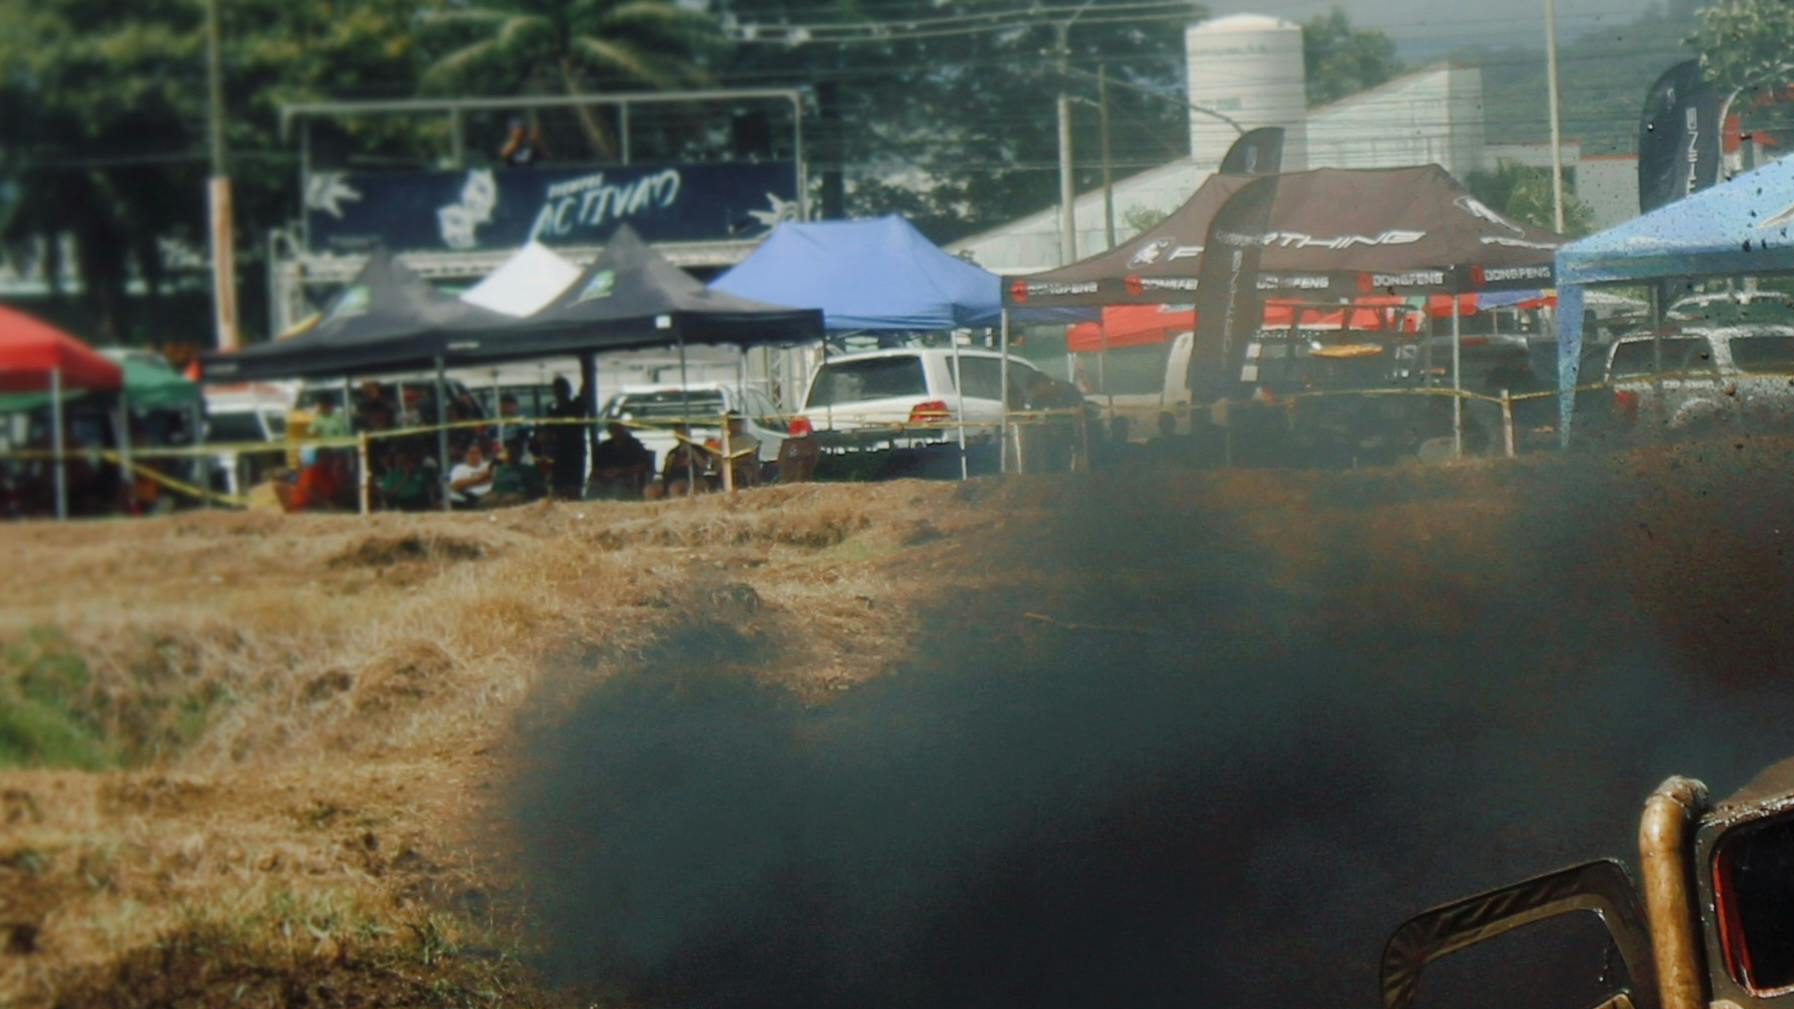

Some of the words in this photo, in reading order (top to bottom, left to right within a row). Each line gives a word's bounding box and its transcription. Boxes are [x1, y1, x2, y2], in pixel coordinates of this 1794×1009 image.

[1684, 107, 1699, 198] THING
[1372, 271, 1444, 287] DONGFENG
[1484, 266, 1552, 281] DONGFENG
